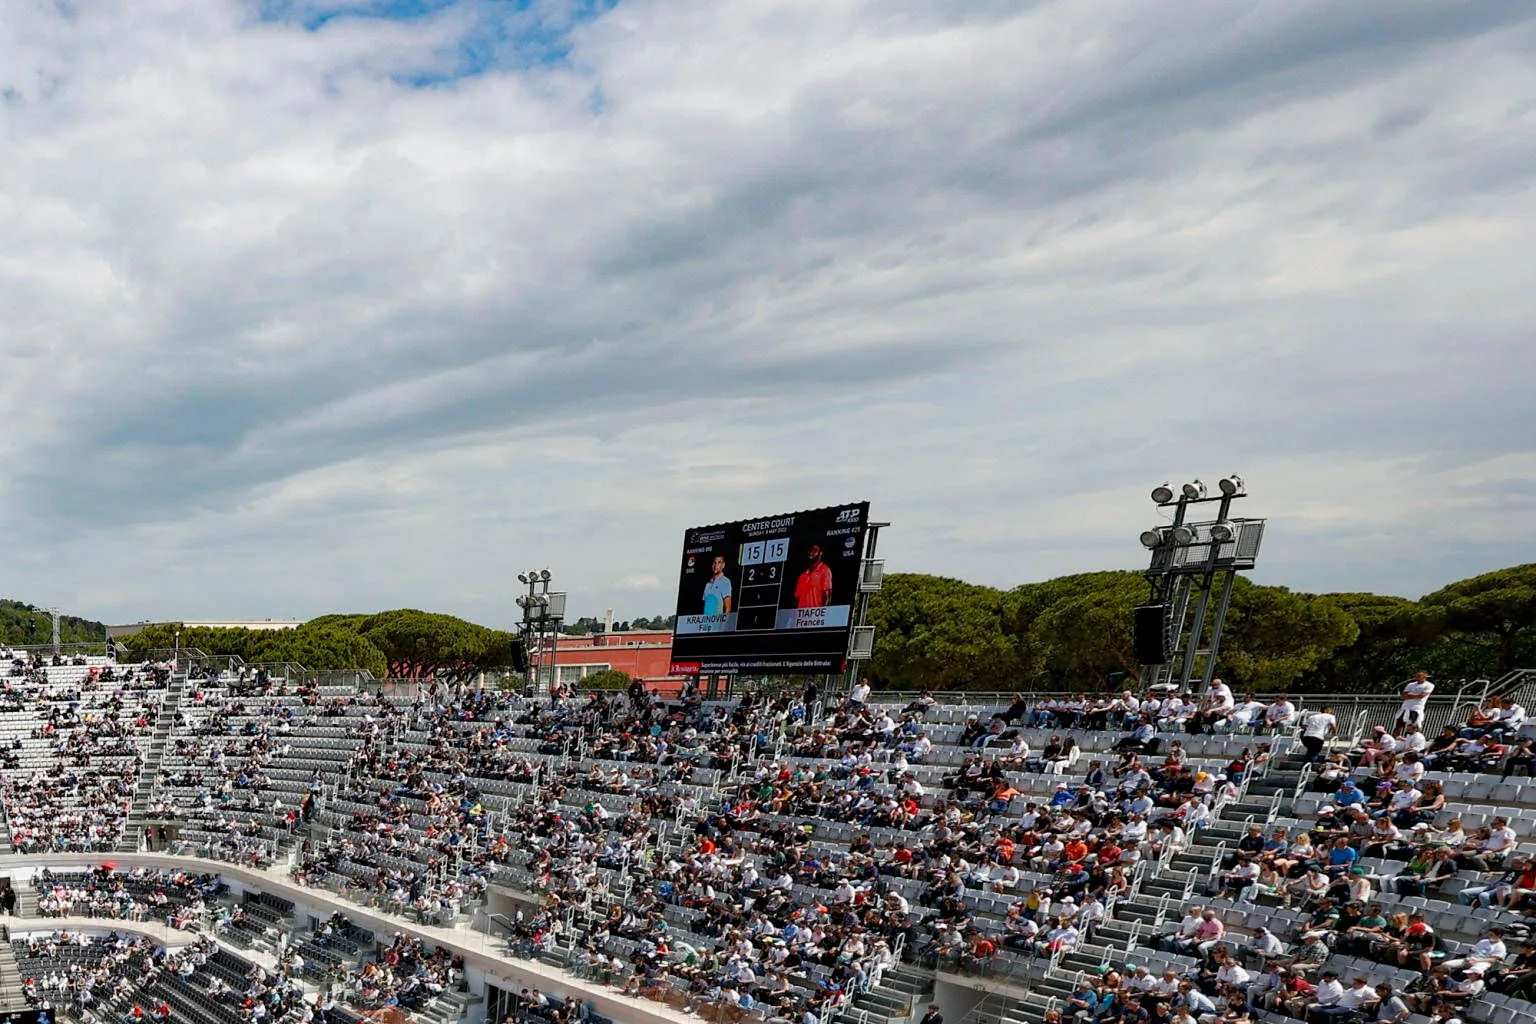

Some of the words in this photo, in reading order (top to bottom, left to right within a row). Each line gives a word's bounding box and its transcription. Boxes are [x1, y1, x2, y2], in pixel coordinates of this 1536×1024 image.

[836, 508, 860, 521] ATP
[742, 521, 770, 533] CENTER
[771, 517, 795, 529] COURT
[748, 545, 761, 560] 15
[770, 543, 784, 558] 15
[747, 568, 756, 581] 2
[769, 566, 777, 579] 3
[797, 607, 827, 618] TIAFOE
[686, 614, 727, 625] KRAJINOVIC
[796, 618, 825, 627] Frances
